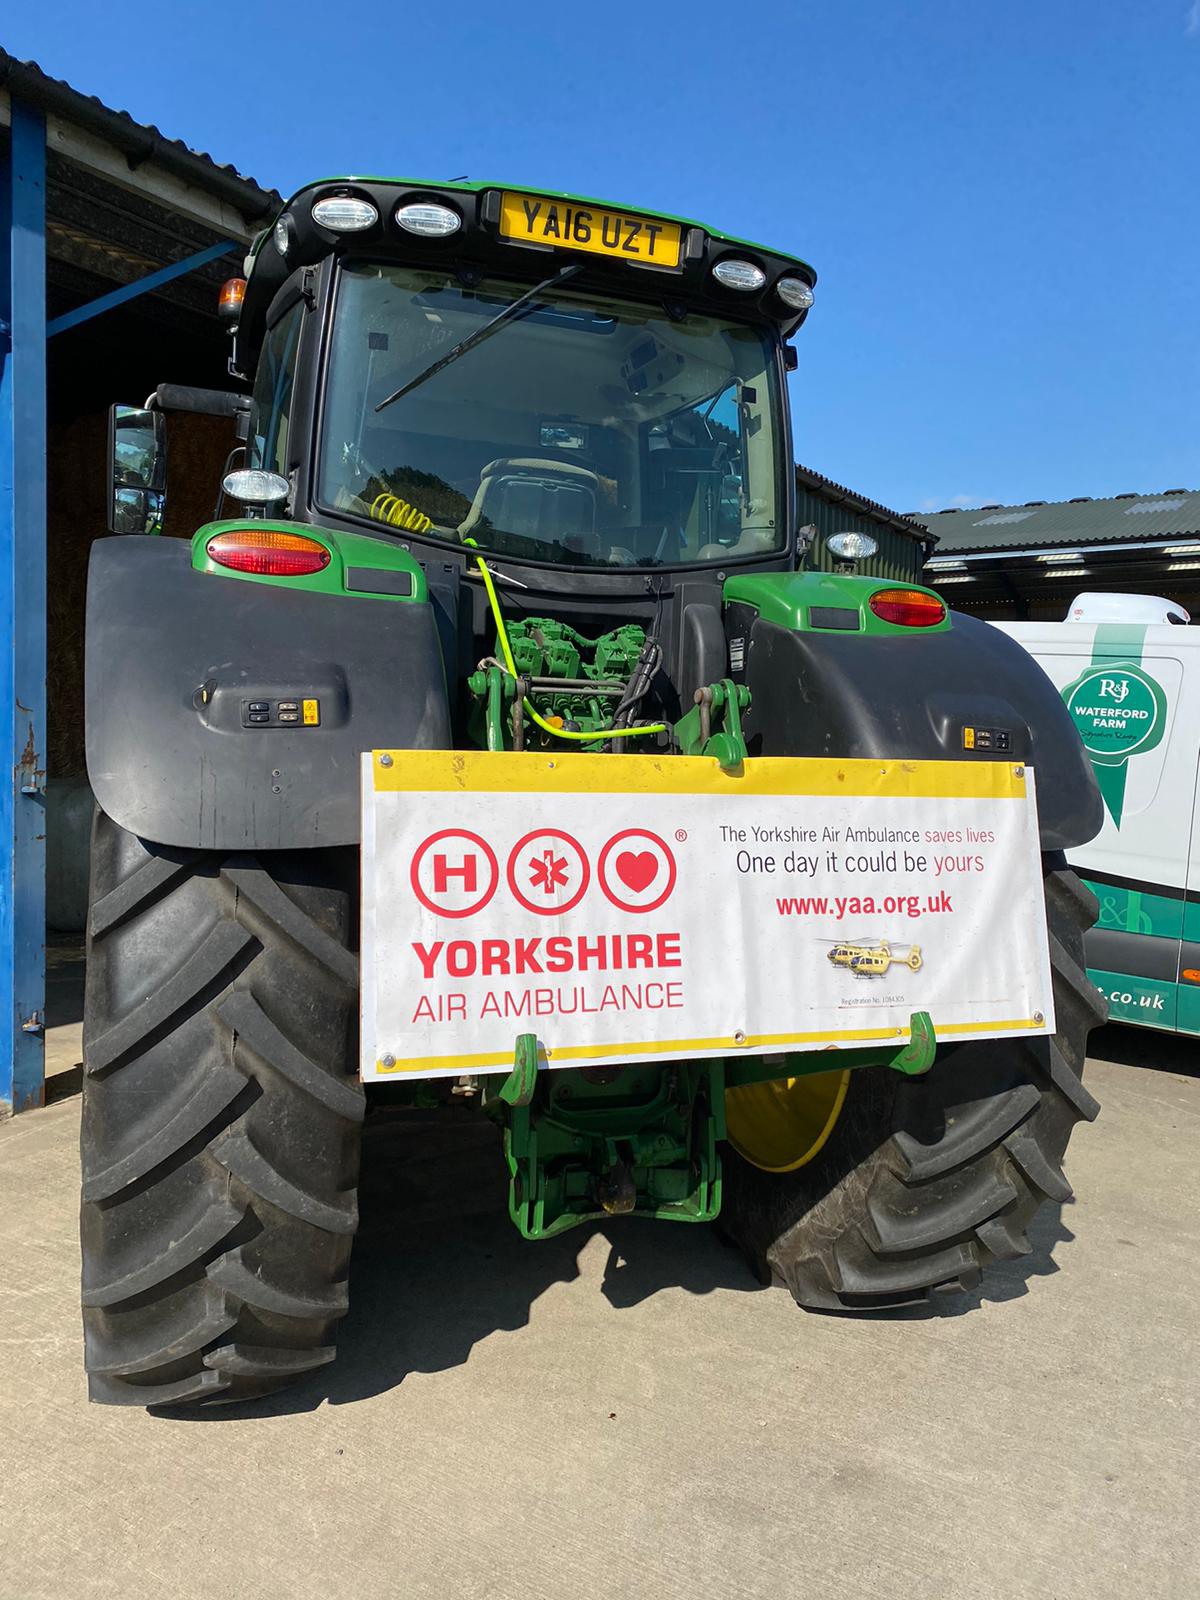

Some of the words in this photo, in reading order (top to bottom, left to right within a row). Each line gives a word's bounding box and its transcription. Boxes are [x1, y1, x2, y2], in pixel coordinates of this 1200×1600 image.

[523, 200, 592, 243] YA16
[602, 216, 662, 256] UZT
[1098, 679, 1129, 703] R&J
[1075, 706, 1149, 719] WATERFORD
[1093, 718, 1127, 729] FARM
[719, 825, 747, 842] The
[751, 826, 817, 842] Yorkshire
[822, 826, 841, 842] Air
[845, 826, 920, 843] Ambulance
[924, 830, 962, 843] saves
[966, 827, 995, 843] lives
[736, 850, 776, 873] One
[784, 850, 819, 878] day
[826, 850, 839, 873] it
[845, 850, 897, 873] could
[904, 850, 927, 873] be
[933, 855, 984, 877] yours
[776, 890, 953, 920] www.yaa.org.uk
[412, 933, 682, 979] YORKSHIRE
[412, 993, 467, 1023] AIR
[480, 982, 684, 1019] AMBULANCE
